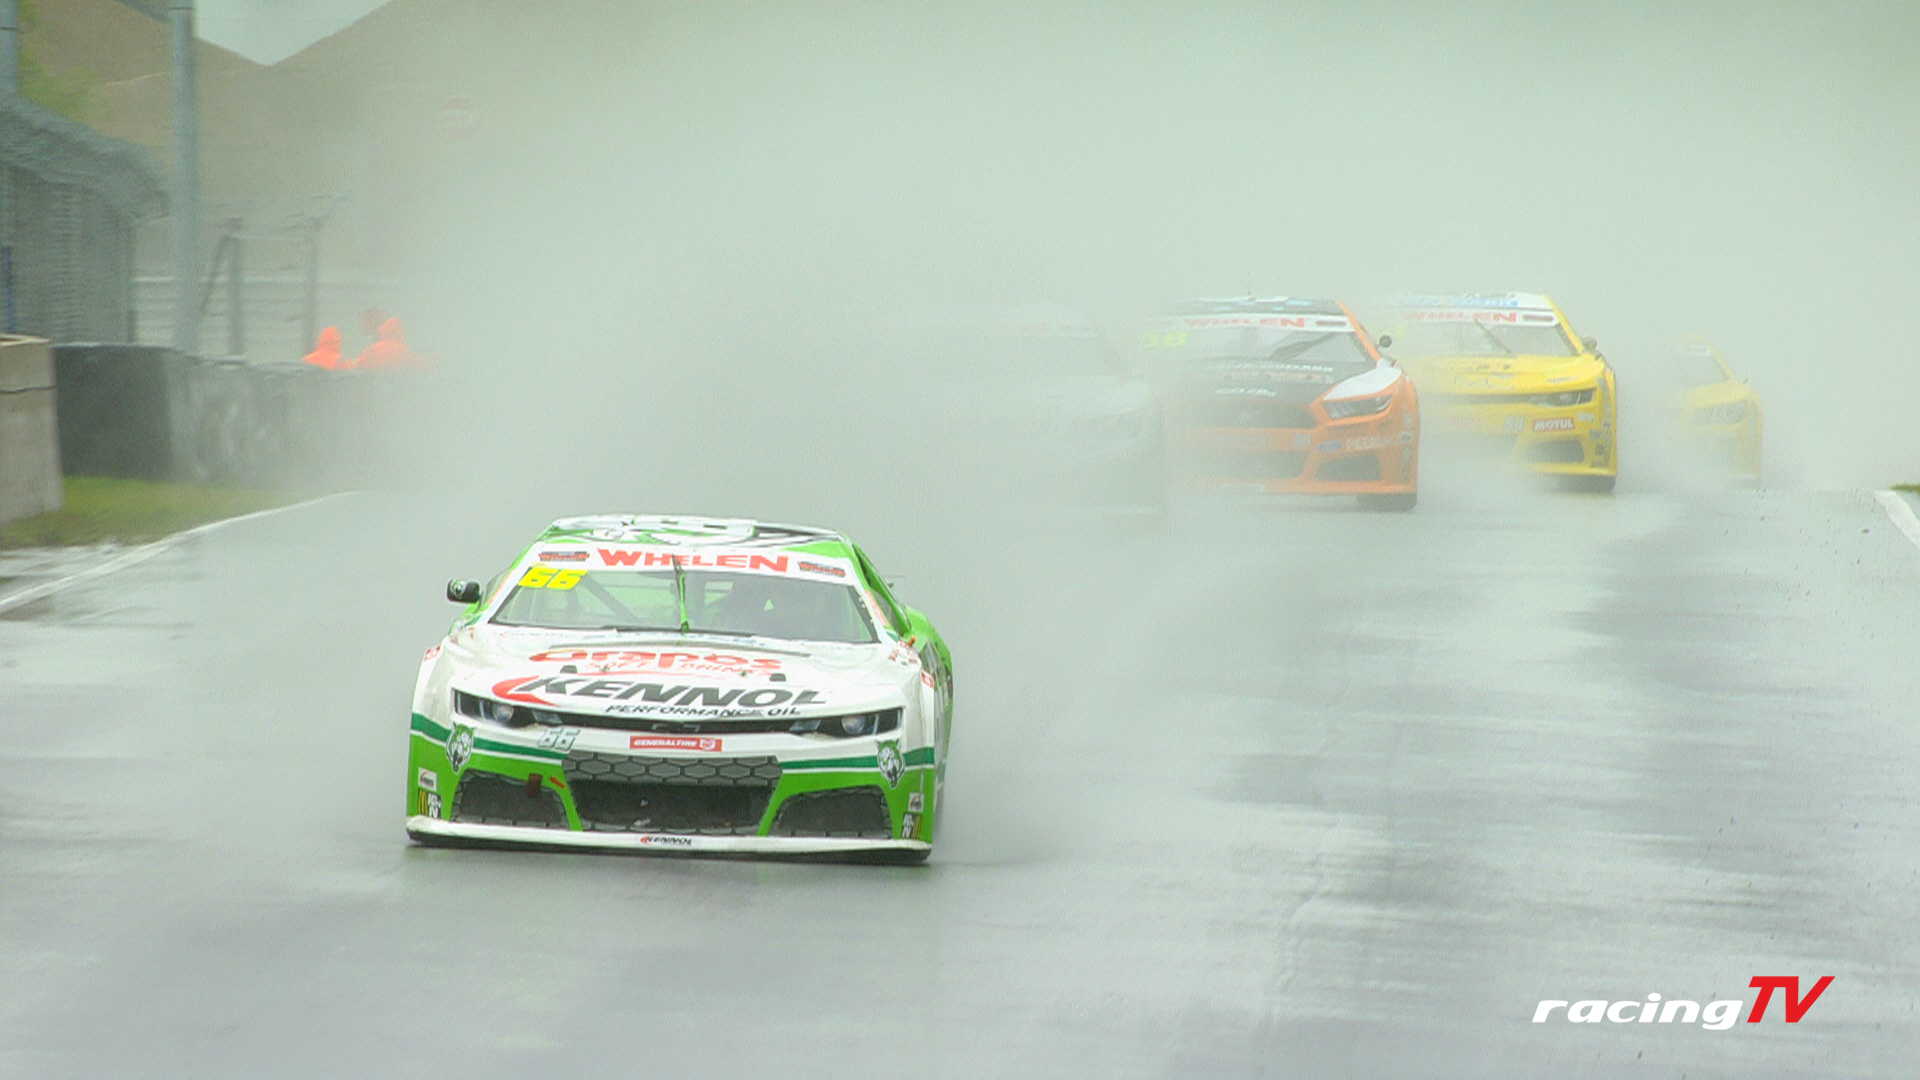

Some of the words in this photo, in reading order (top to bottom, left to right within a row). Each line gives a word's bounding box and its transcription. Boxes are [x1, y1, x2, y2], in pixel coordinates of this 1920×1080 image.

[1534, 419, 1573, 431] MOTUL
[597, 548, 788, 572] WHELEN
[517, 566, 588, 590] 66
[514, 677, 827, 707] KENNOL
[606, 704, 763, 717] PERFORMANCE
[767, 707, 801, 717] OIL
[538, 727, 580, 750] 66
[643, 835, 693, 846] KENNOL
